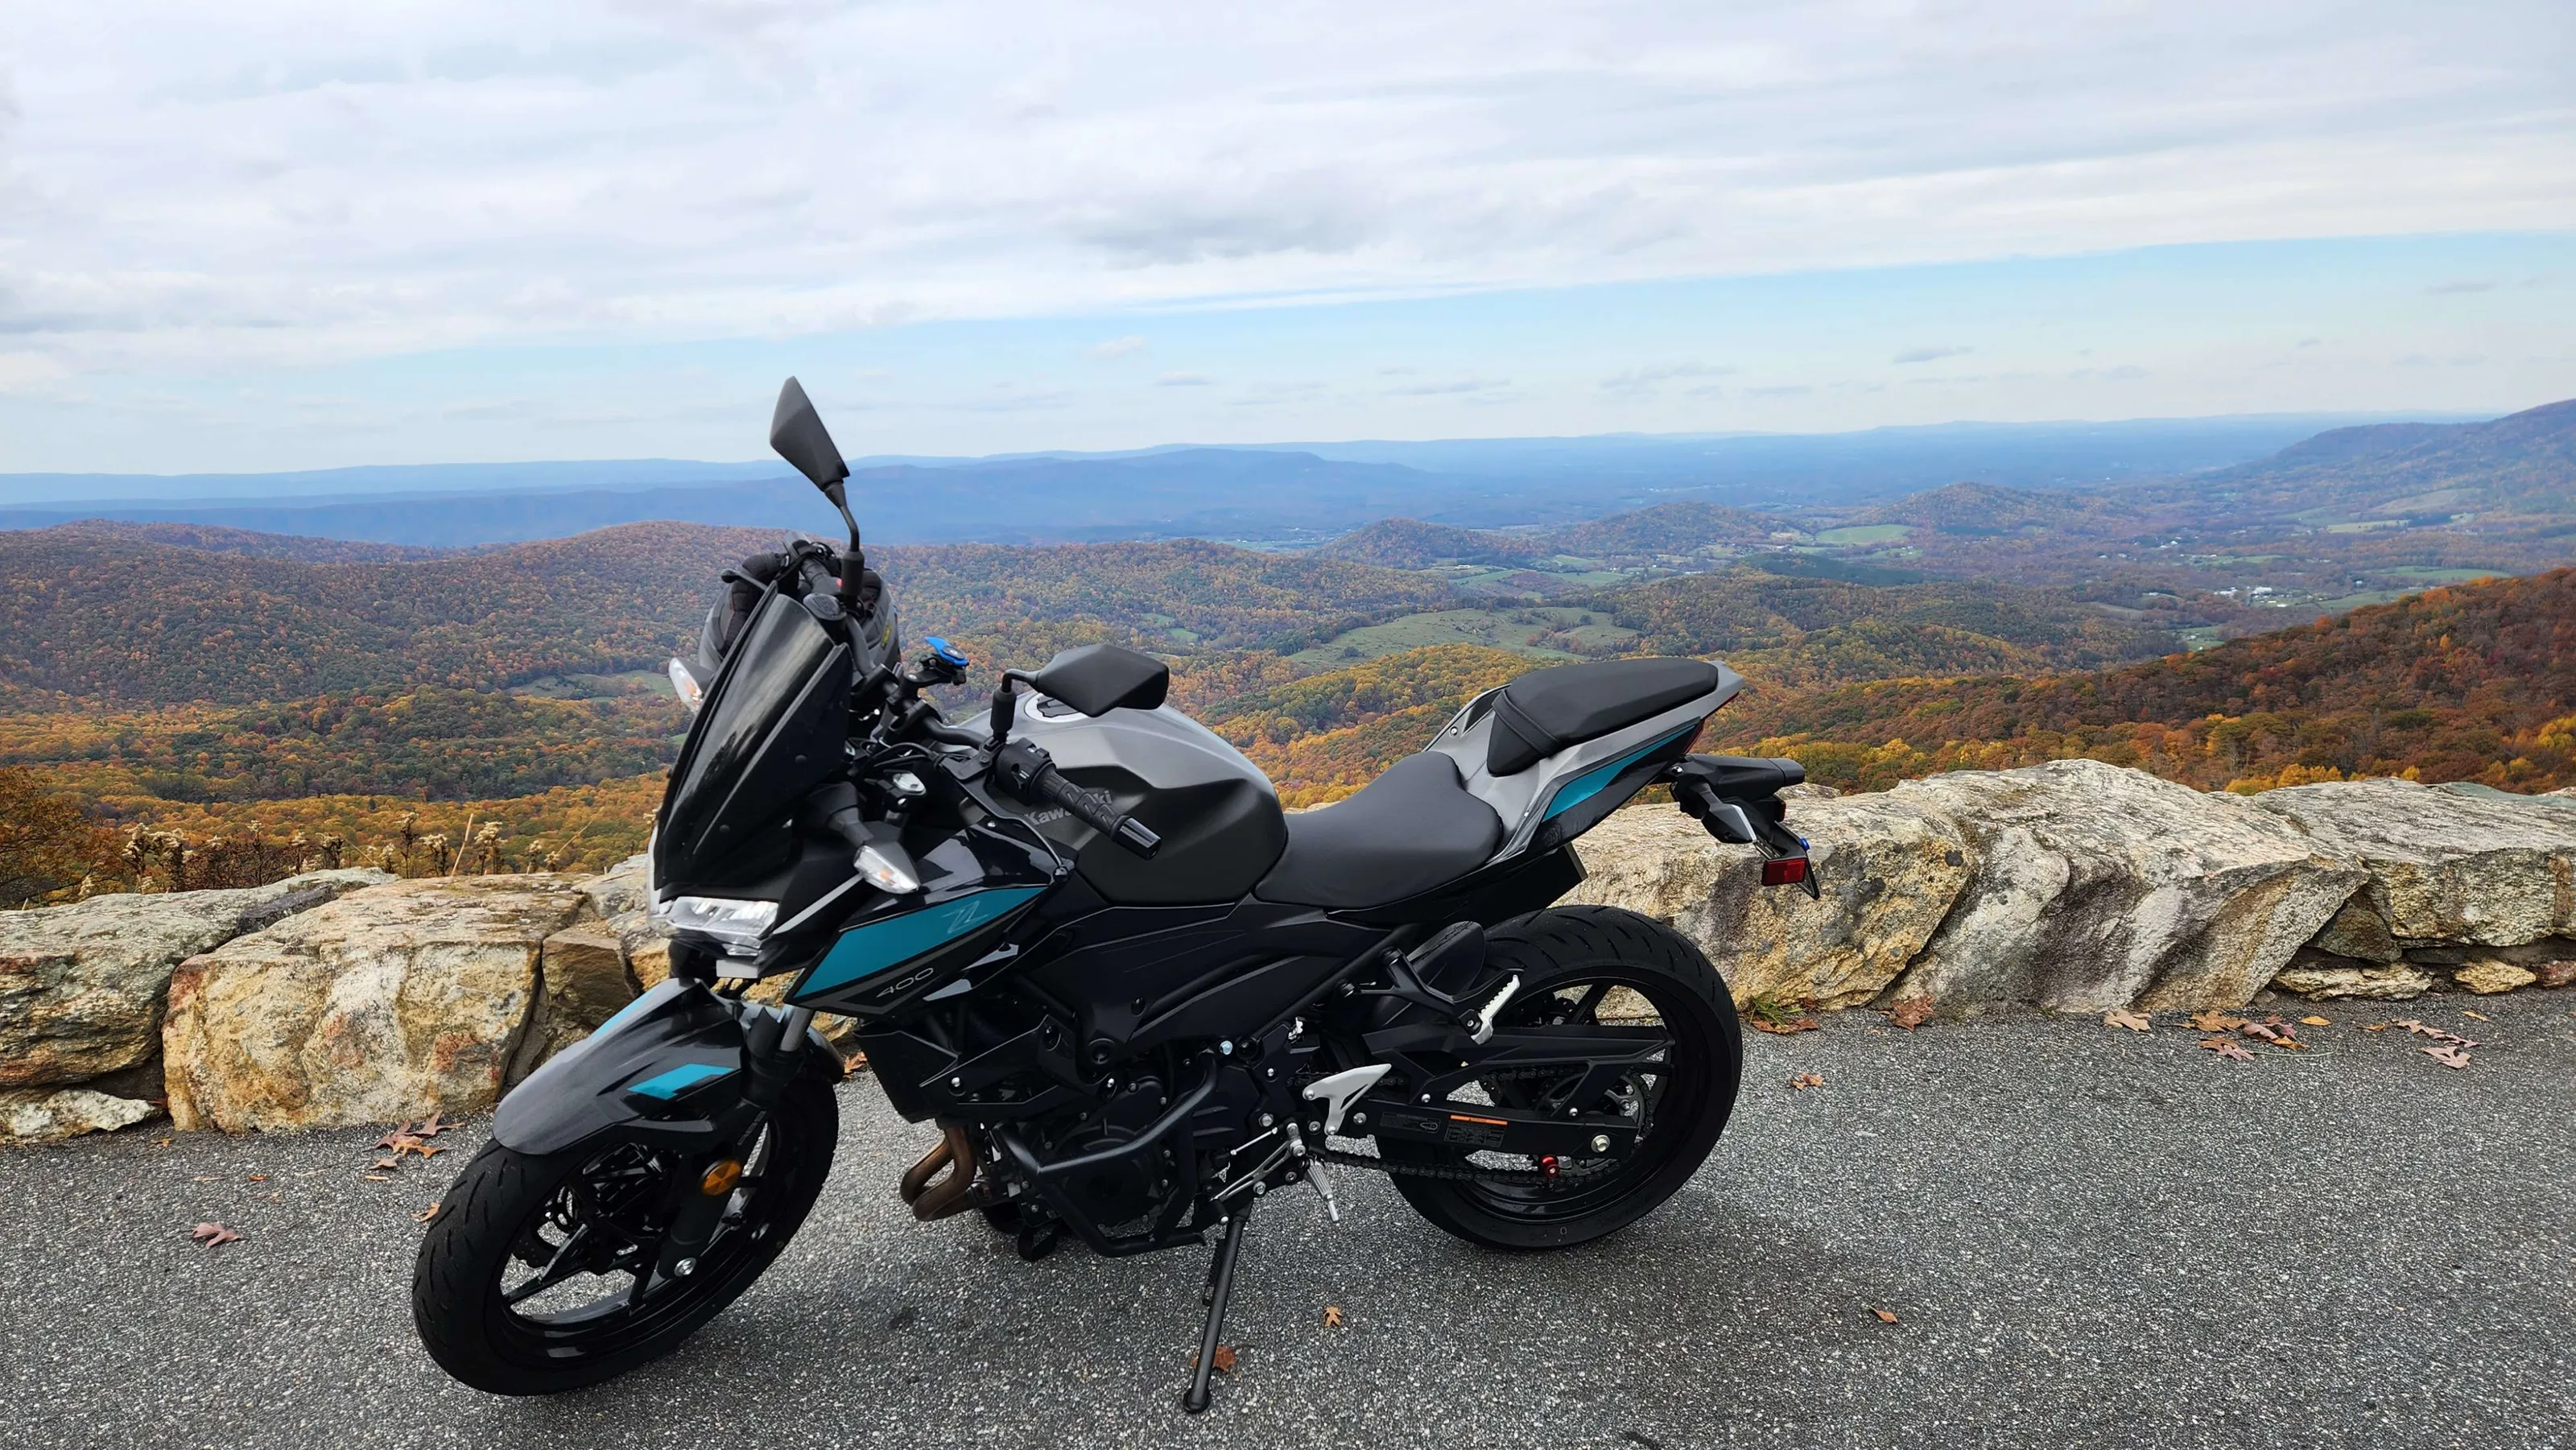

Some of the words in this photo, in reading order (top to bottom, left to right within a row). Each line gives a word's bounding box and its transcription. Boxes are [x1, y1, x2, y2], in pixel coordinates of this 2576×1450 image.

[1024, 790, 1113, 825] Kawki
[941, 899, 991, 934] Z
[876, 967, 934, 998] 400
